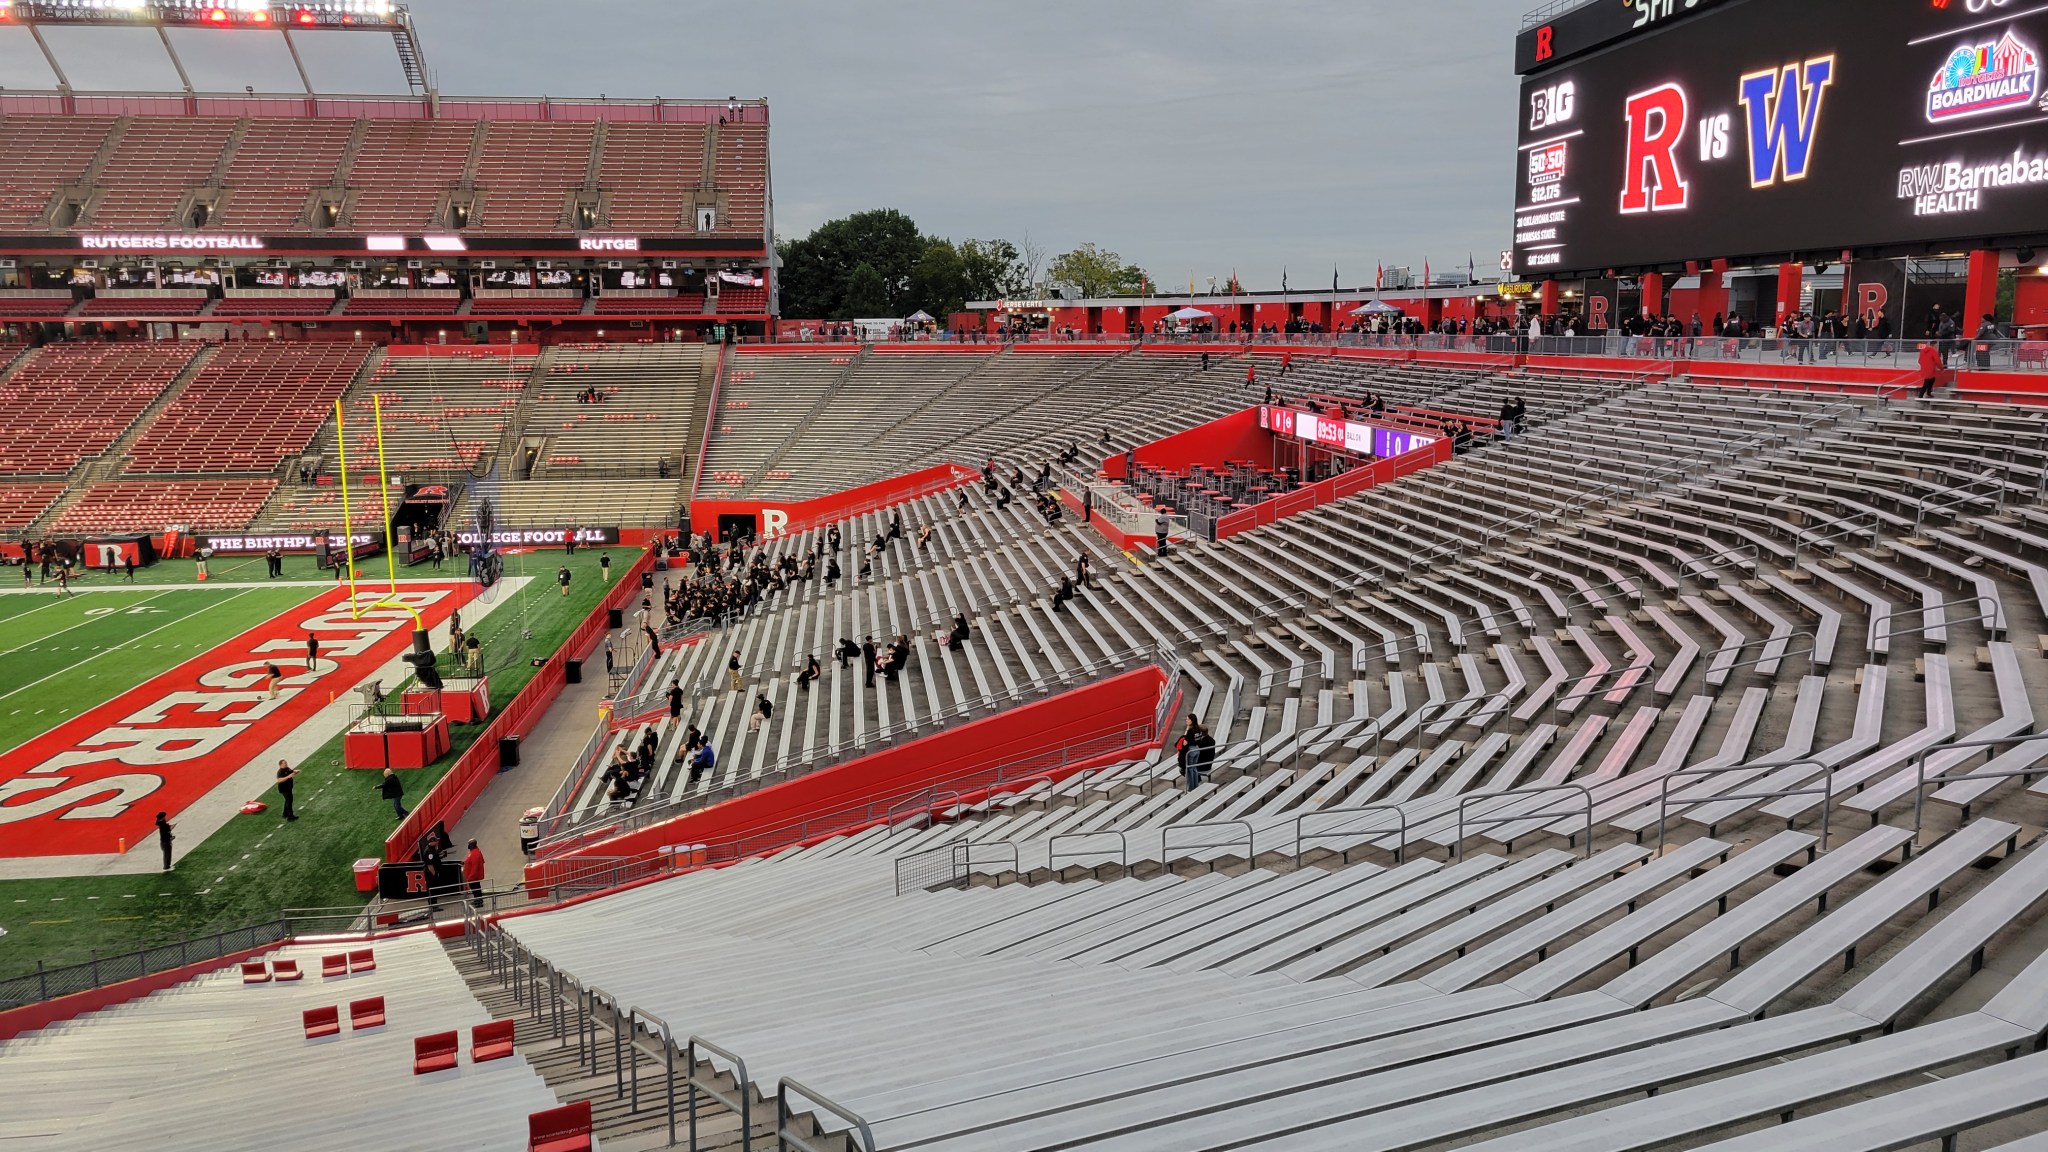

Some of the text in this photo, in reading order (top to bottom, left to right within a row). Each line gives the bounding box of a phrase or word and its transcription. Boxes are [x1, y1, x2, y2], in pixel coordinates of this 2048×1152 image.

[1535, 25, 1553, 62] R
[1931, 74, 2032, 111] BOARDWALK
[1620, 54, 1834, 214] R VS W
[1531, 184, 1560, 203] $12,175
[1914, 189, 1979, 215] HEALTH
[1523, 212, 1550, 226] OKLAHOMA
[1549, 210, 1566, 223] STATE
[82, 237, 263, 249] RUTGERS FOOTBALL
[1521, 230, 1541, 242] KANSAS
[1540, 228, 1556, 240] STATE
[1527, 255, 1537, 266] SAT
[1551, 252, 1560, 263] PM
[1026, 300, 1043, 308] EATS
[1588, 296, 1609, 330] R
[1857, 282, 1888, 329] R
[1260, 407, 1268, 428] R
[762, 509, 788, 539] R
[207, 538, 242, 550] THE
[244, 536, 346, 550] BIRTHPLCE
[456, 530, 605, 544] OLEGE FOOTALL
[98, 544, 127, 567] R
[0, 589, 454, 825] RUTGERS
[405, 870, 427, 893] R
